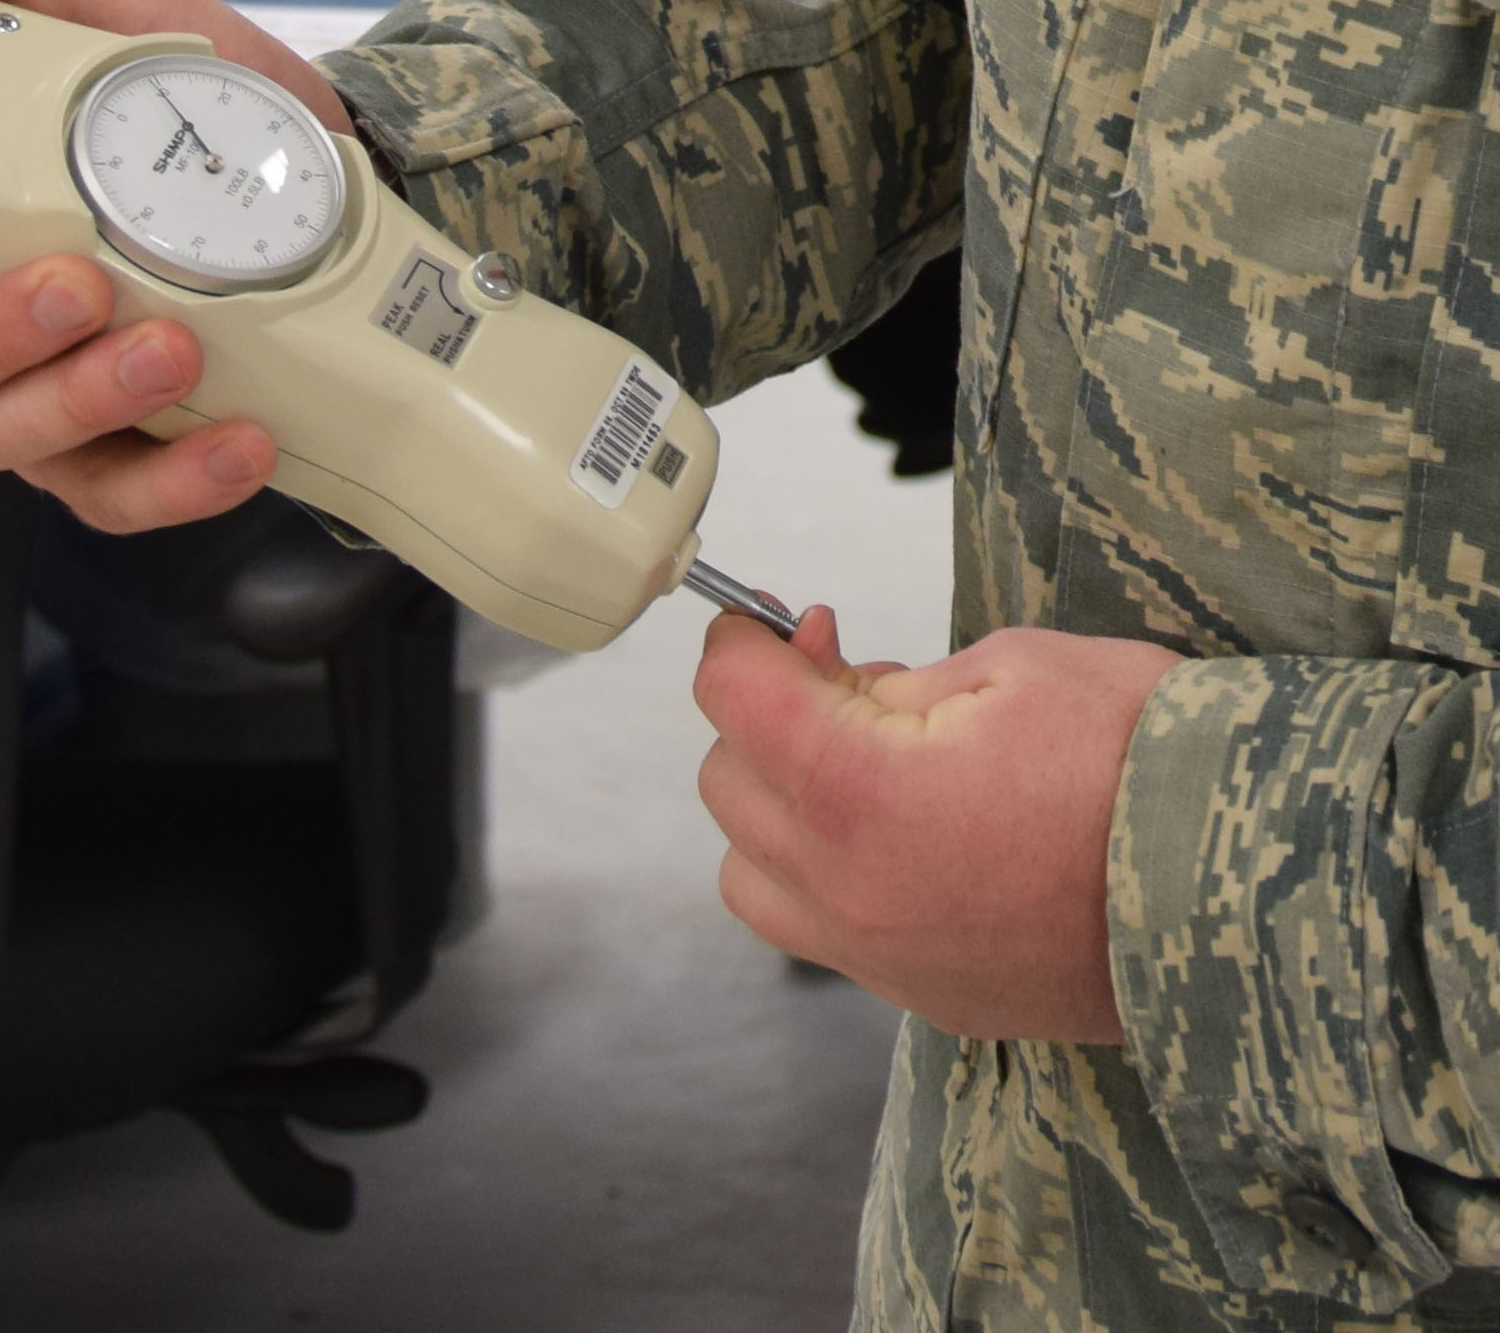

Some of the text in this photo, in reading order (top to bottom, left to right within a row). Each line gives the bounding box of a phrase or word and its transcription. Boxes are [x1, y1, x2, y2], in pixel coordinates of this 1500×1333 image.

[218, 91, 232, 105] 20
[268, 119, 282, 134] 30
[109, 155, 124, 171] 90
[225, 167, 249, 198] 100LB
[299, 169, 314, 184] 40
[140, 205, 155, 221] 80
[293, 213, 309, 229] 50
[192, 235, 206, 250] 70
[253, 238, 269, 254] 60
[381, 301, 404, 331] PEAK
[395, 285, 431, 337] PUSH RESET
[429, 333, 452, 357] REAL
[658, 450, 678, 478] PUSH
